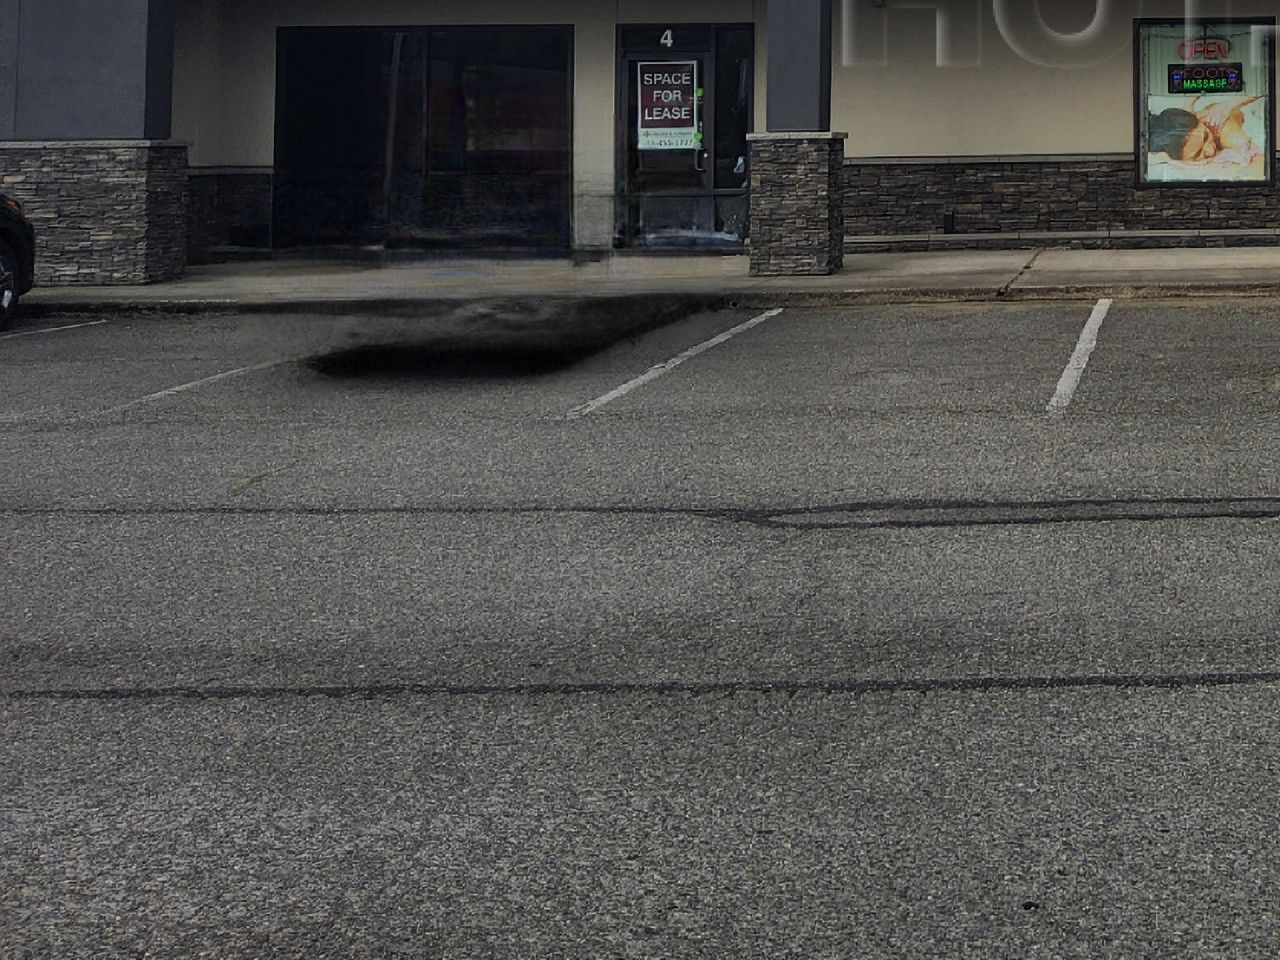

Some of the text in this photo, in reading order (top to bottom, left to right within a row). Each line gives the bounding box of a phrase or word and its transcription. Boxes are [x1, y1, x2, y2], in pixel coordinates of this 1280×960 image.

[660, 29, 673, 48] 4
[1178, 39, 1230, 60] OPEN
[643, 73, 691, 86] SPACE
[653, 90, 682, 102] FOR
[644, 107, 691, 120] LEASE
